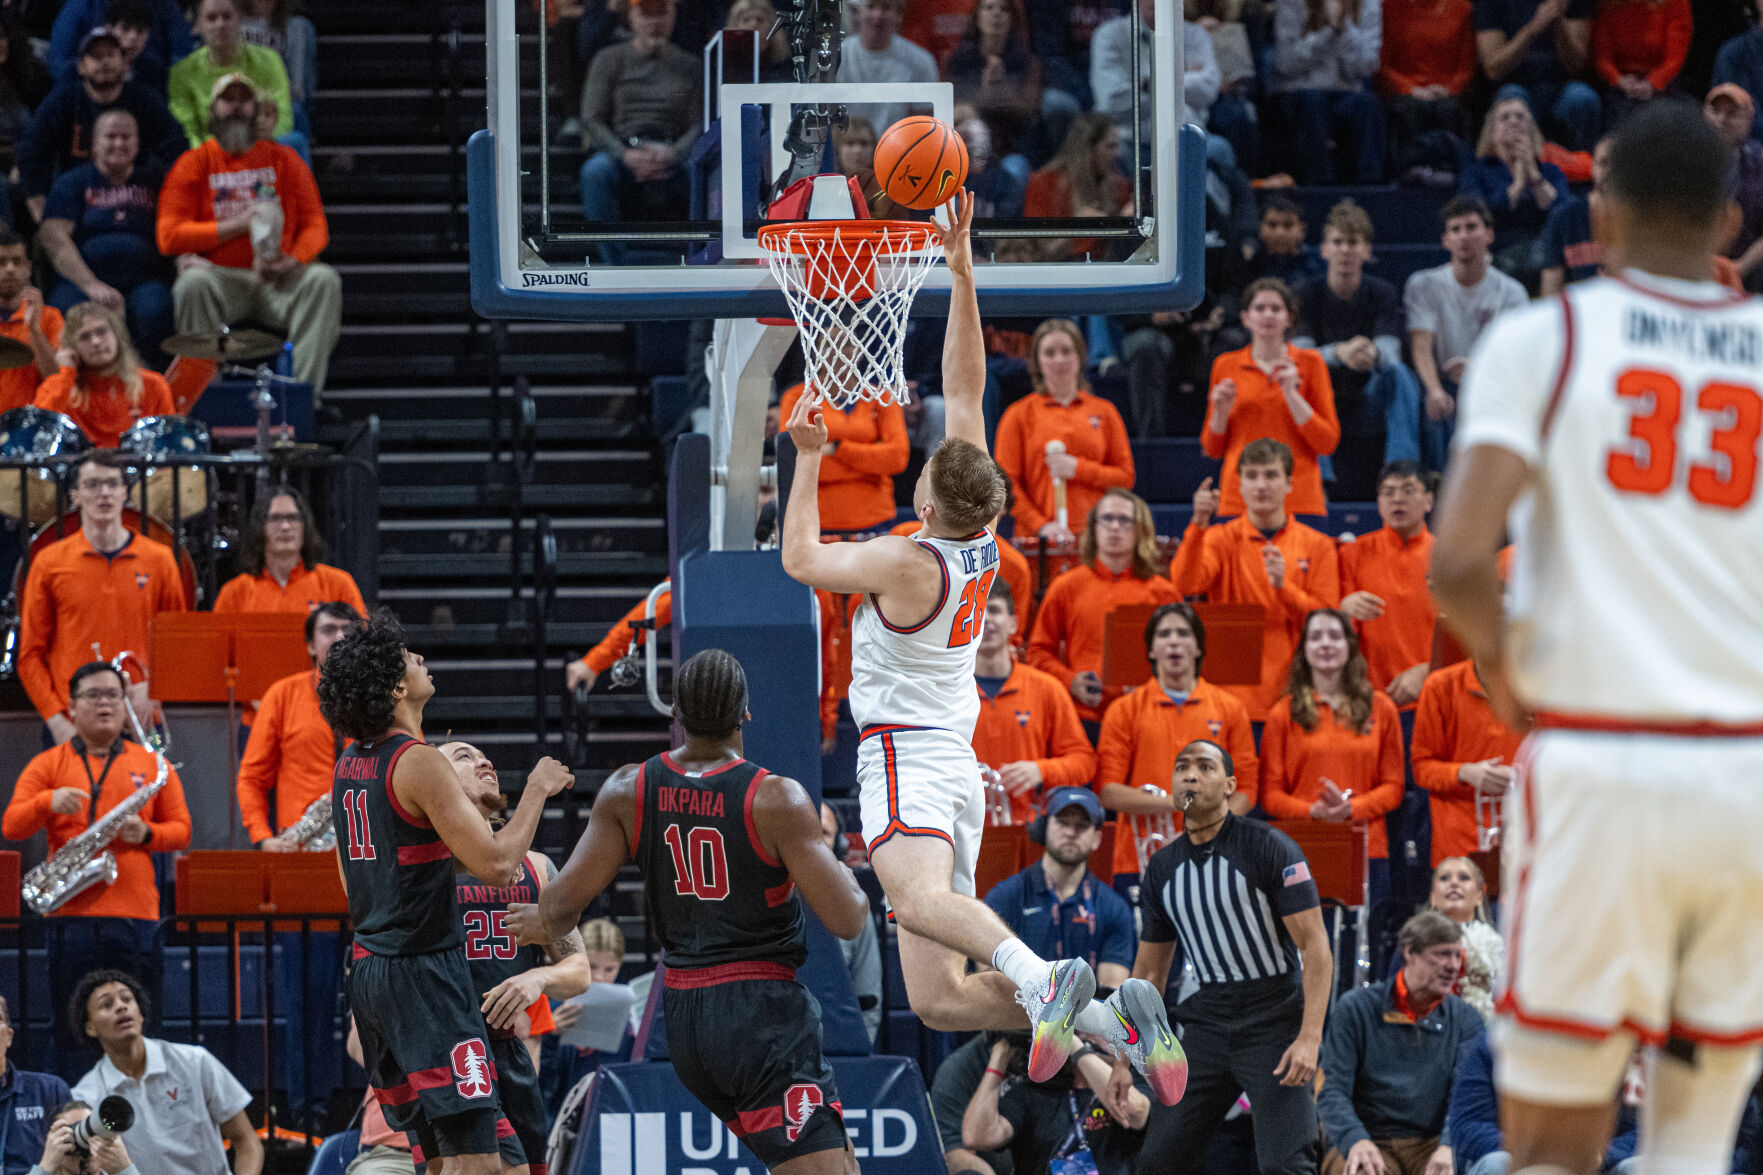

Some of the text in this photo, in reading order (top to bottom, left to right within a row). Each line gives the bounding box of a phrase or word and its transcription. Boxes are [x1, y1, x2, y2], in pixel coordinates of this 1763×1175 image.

[522, 272, 588, 287] SPALDING
[1606, 367, 1763, 511] 33
[960, 540, 999, 574] DE RIDDE
[946, 568, 994, 649] 28
[336, 756, 380, 780] AGARWAL
[658, 786, 725, 817] OKPARA
[343, 789, 376, 860] 11
[664, 823, 730, 901] 10
[456, 884, 531, 905] TANFORD
[463, 910, 517, 960] 25
